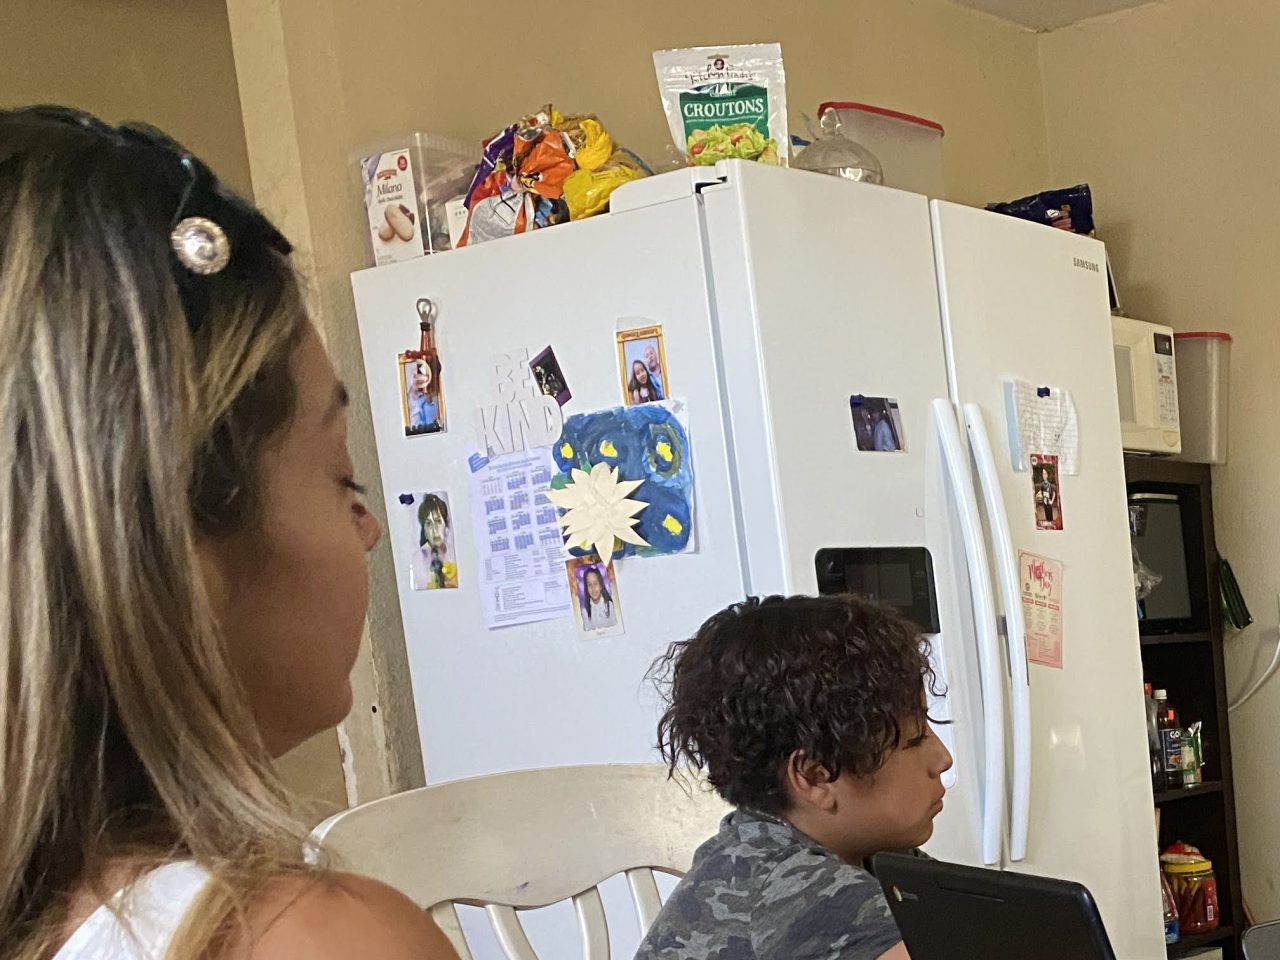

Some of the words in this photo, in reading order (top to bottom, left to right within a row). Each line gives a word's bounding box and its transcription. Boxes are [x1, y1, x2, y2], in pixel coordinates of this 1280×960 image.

[683, 98, 764, 118] CROUTONS
[376, 182, 402, 197] Milano
[474, 394, 563, 457] KIND
